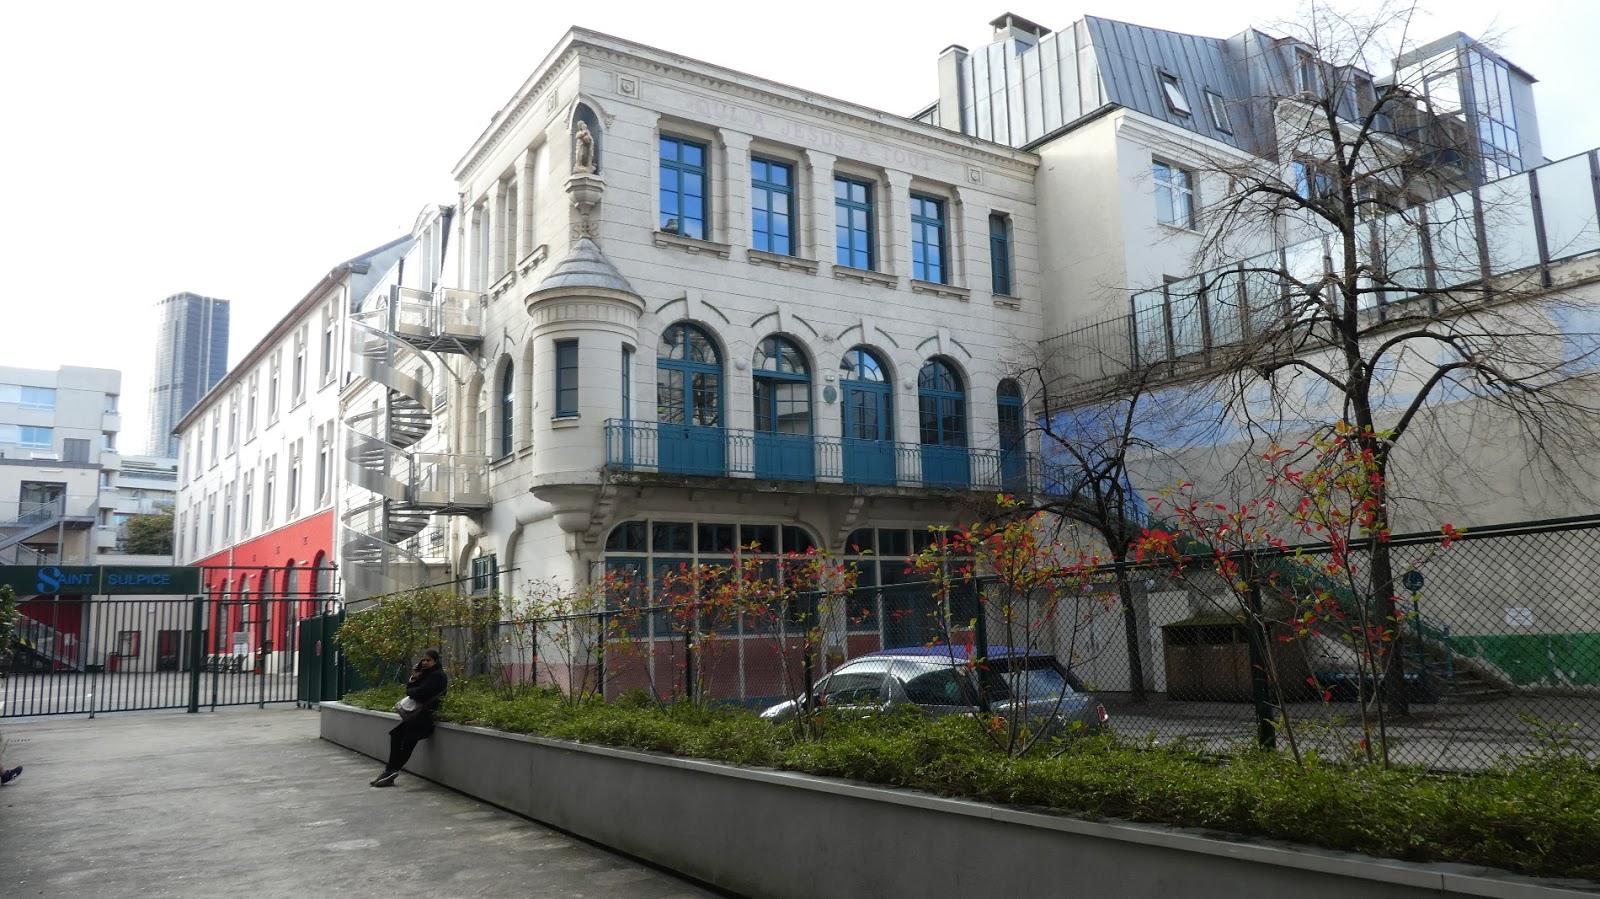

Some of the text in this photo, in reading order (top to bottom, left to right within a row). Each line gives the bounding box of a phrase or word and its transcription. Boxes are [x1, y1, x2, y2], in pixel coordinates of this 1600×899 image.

[753, 113, 766, 130] A
[781, 121, 845, 151] JESUS
[858, 141, 872, 156] A
[883, 146, 929, 171] TOUT
[36, 566, 172, 594] SAINT SULPICE
